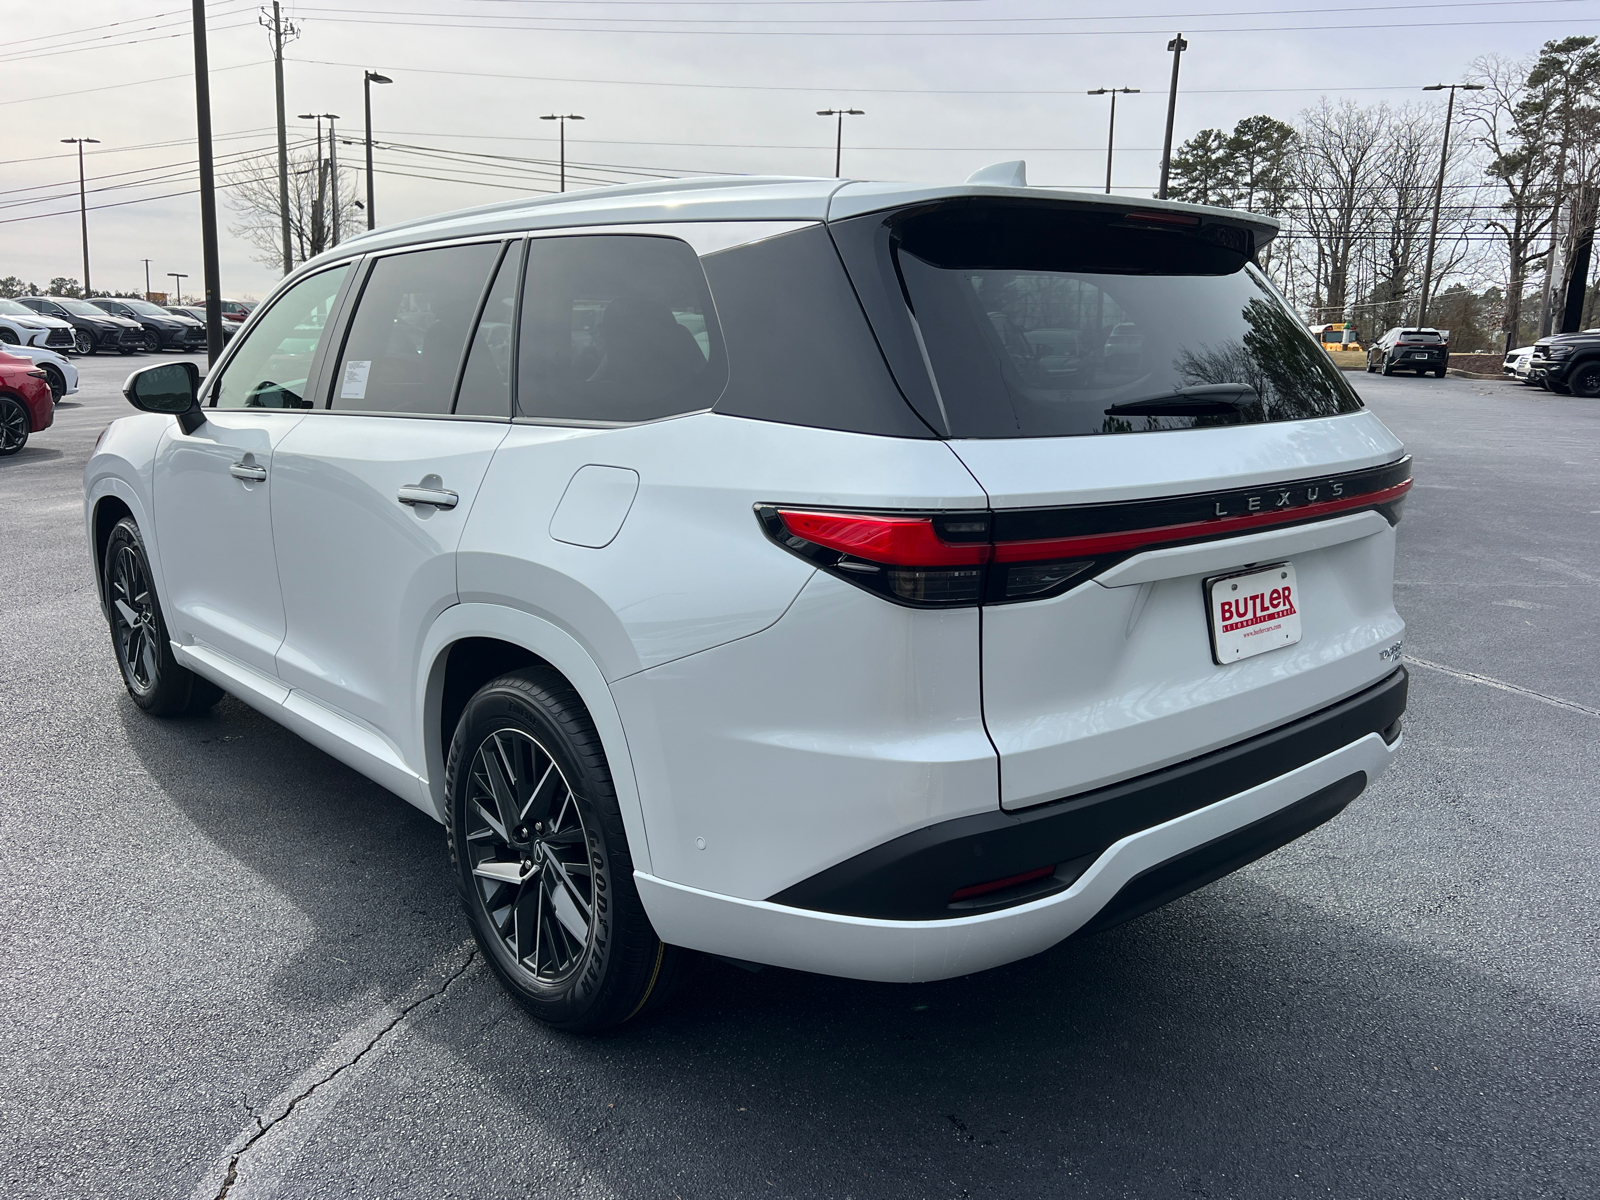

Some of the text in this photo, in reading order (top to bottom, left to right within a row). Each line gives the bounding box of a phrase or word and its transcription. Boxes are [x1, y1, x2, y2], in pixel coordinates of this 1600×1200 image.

[1215, 483, 1344, 517] LEXUS
[1274, 607, 1296, 619] GROUP
[1243, 624, 1282, 638] www.butlercars.com
